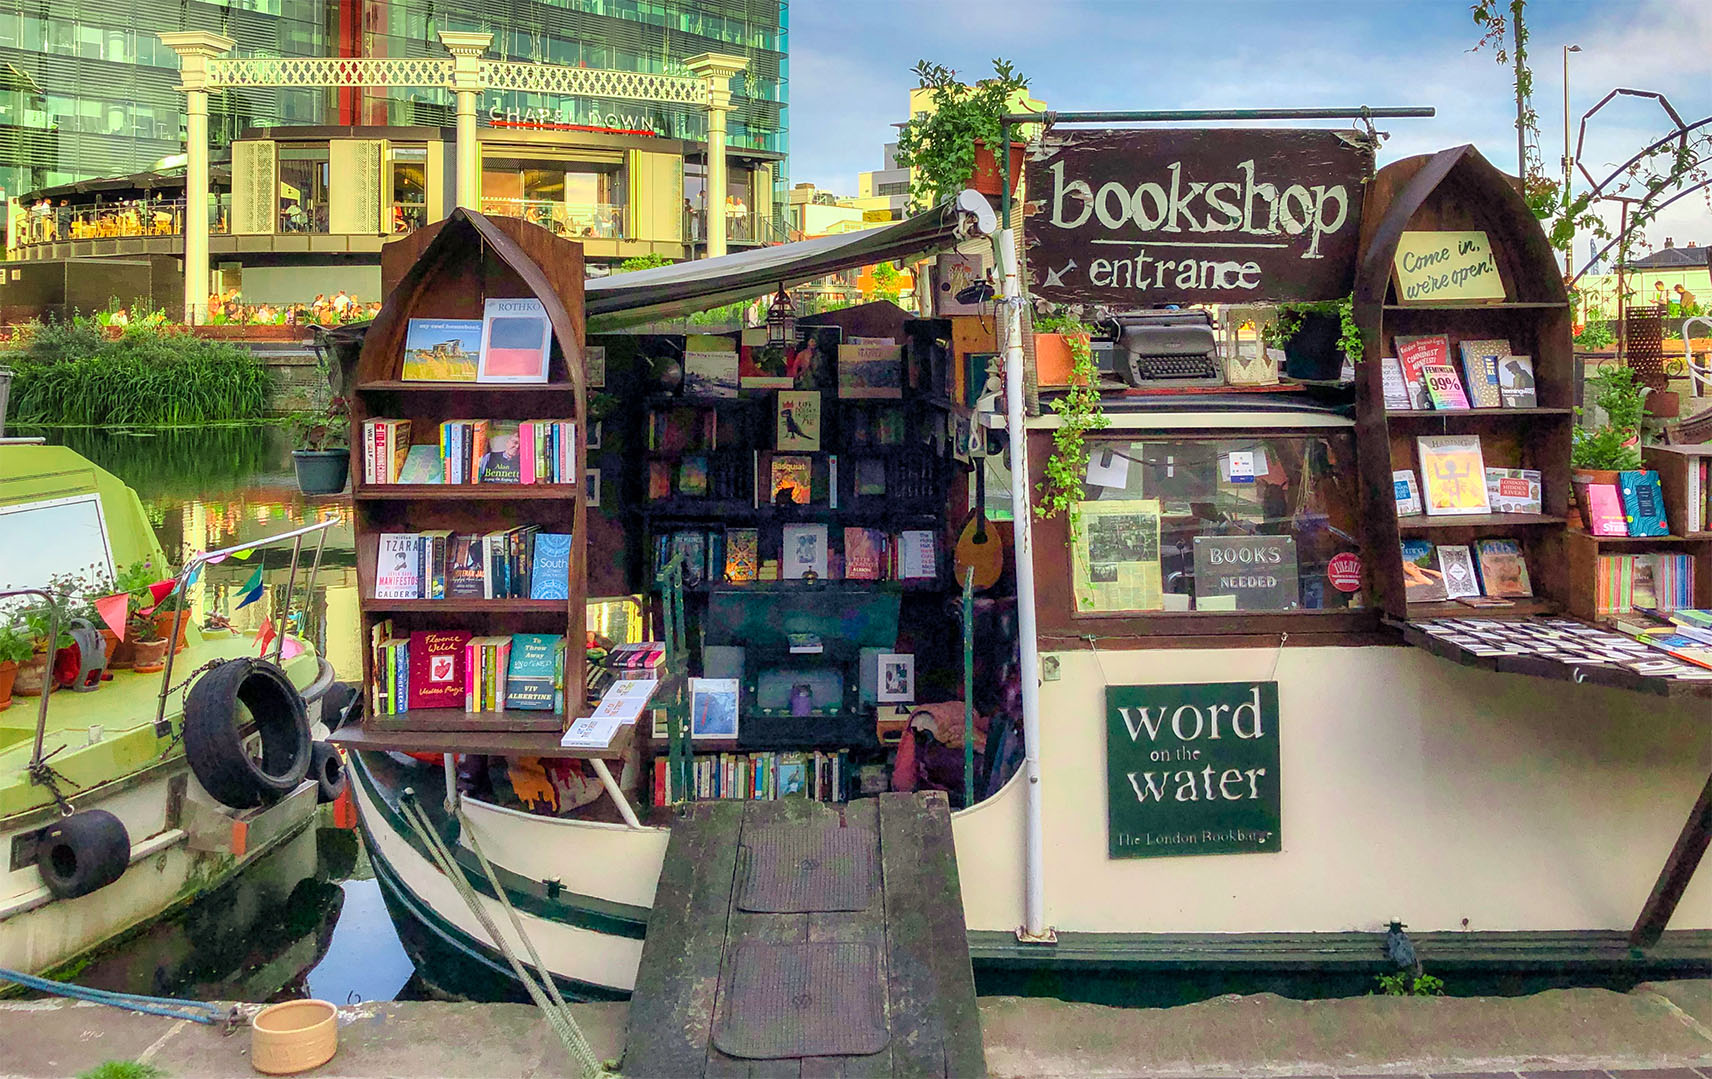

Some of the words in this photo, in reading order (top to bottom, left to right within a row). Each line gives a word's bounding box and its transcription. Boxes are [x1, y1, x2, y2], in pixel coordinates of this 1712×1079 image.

[488, 106, 579, 126] CHAPEL
[588, 111, 654, 130] DOWN
[1049, 159, 1350, 260] bookshop
[1402, 247, 1450, 274] Come
[1458, 239, 1480, 256] in,
[1089, 249, 1264, 292] entrance
[1406, 272, 1450, 299] we're
[1451, 253, 1494, 288] open!
[498, 303, 541, 311] ROTHKO
[1407, 348, 1439, 364] COMMUNIST
[1425, 366, 1455, 374] FEMINISM
[1430, 377, 1460, 391] 99%
[485, 468, 519, 478] Bennett
[773, 462, 806, 472] Basquiat
[386, 540, 418, 551] TZARA
[1209, 546, 1282, 565] BOOKS
[540, 557, 568, 569] South
[378, 576, 419, 586] MANIFESTOS
[1220, 575, 1278, 589] NEEDED
[378, 590, 410, 598] CALDER
[425, 634, 463, 644] Florence
[428, 643, 458, 653] Welch
[1117, 685, 1266, 742] word
[1150, 749, 1170, 762] on
[1176, 746, 1201, 761] the
[1127, 763, 1266, 803] water
[1118, 833, 1140, 847] The
[1146, 831, 1197, 845] London
